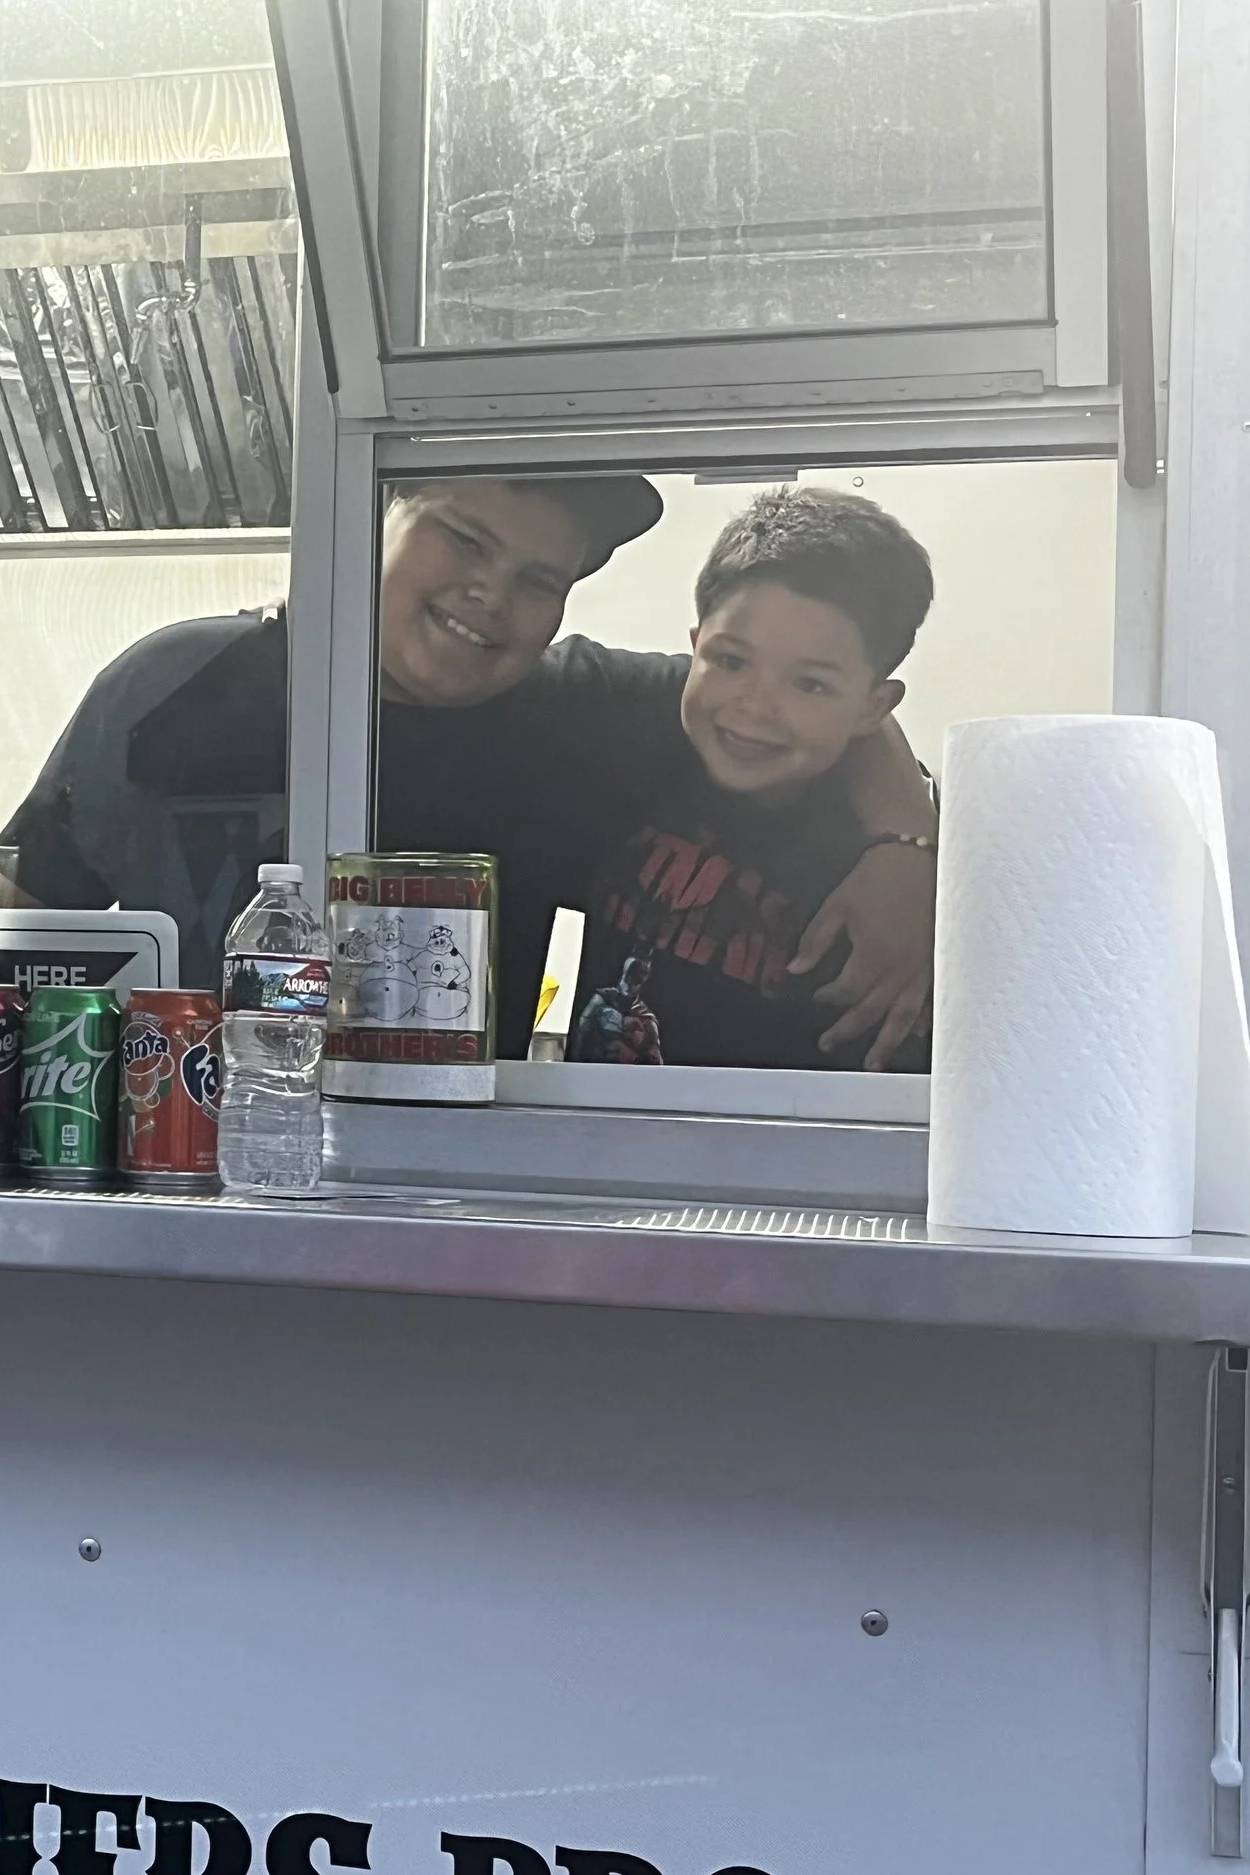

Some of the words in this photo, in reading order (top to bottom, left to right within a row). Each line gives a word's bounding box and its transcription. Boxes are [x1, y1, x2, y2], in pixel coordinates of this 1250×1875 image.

[329, 875, 371, 904] BIG
[377, 876, 490, 906] BELLY
[14, 964, 87, 992] HERE
[282, 977, 329, 995] ARROWHE
[123, 1029, 170, 1067] anta
[20, 1050, 91, 1099] rite
